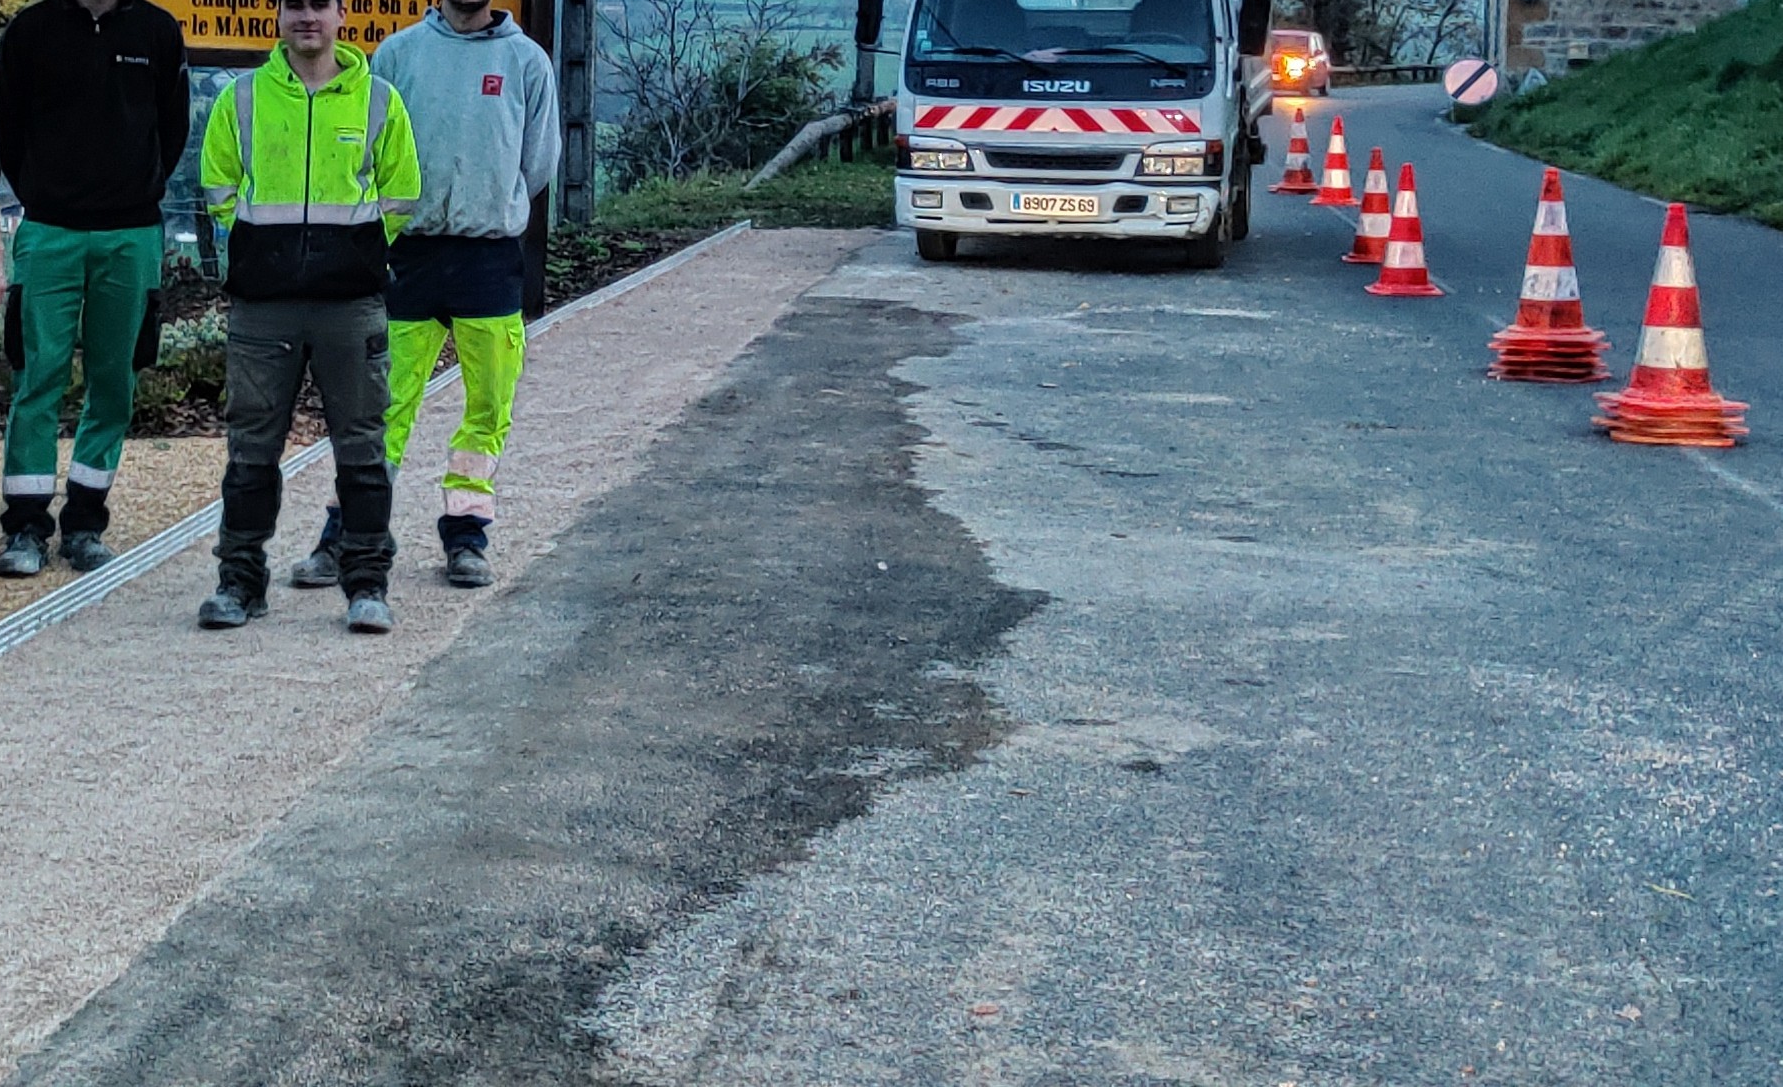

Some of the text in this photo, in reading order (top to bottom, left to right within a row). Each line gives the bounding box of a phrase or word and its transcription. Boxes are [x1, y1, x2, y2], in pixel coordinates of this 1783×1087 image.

[192, 14, 208, 36] le
[364, 21, 385, 42] de
[1022, 80, 1091, 92] ISUZU
[1023, 196, 1095, 213] 8907 ZS 69
